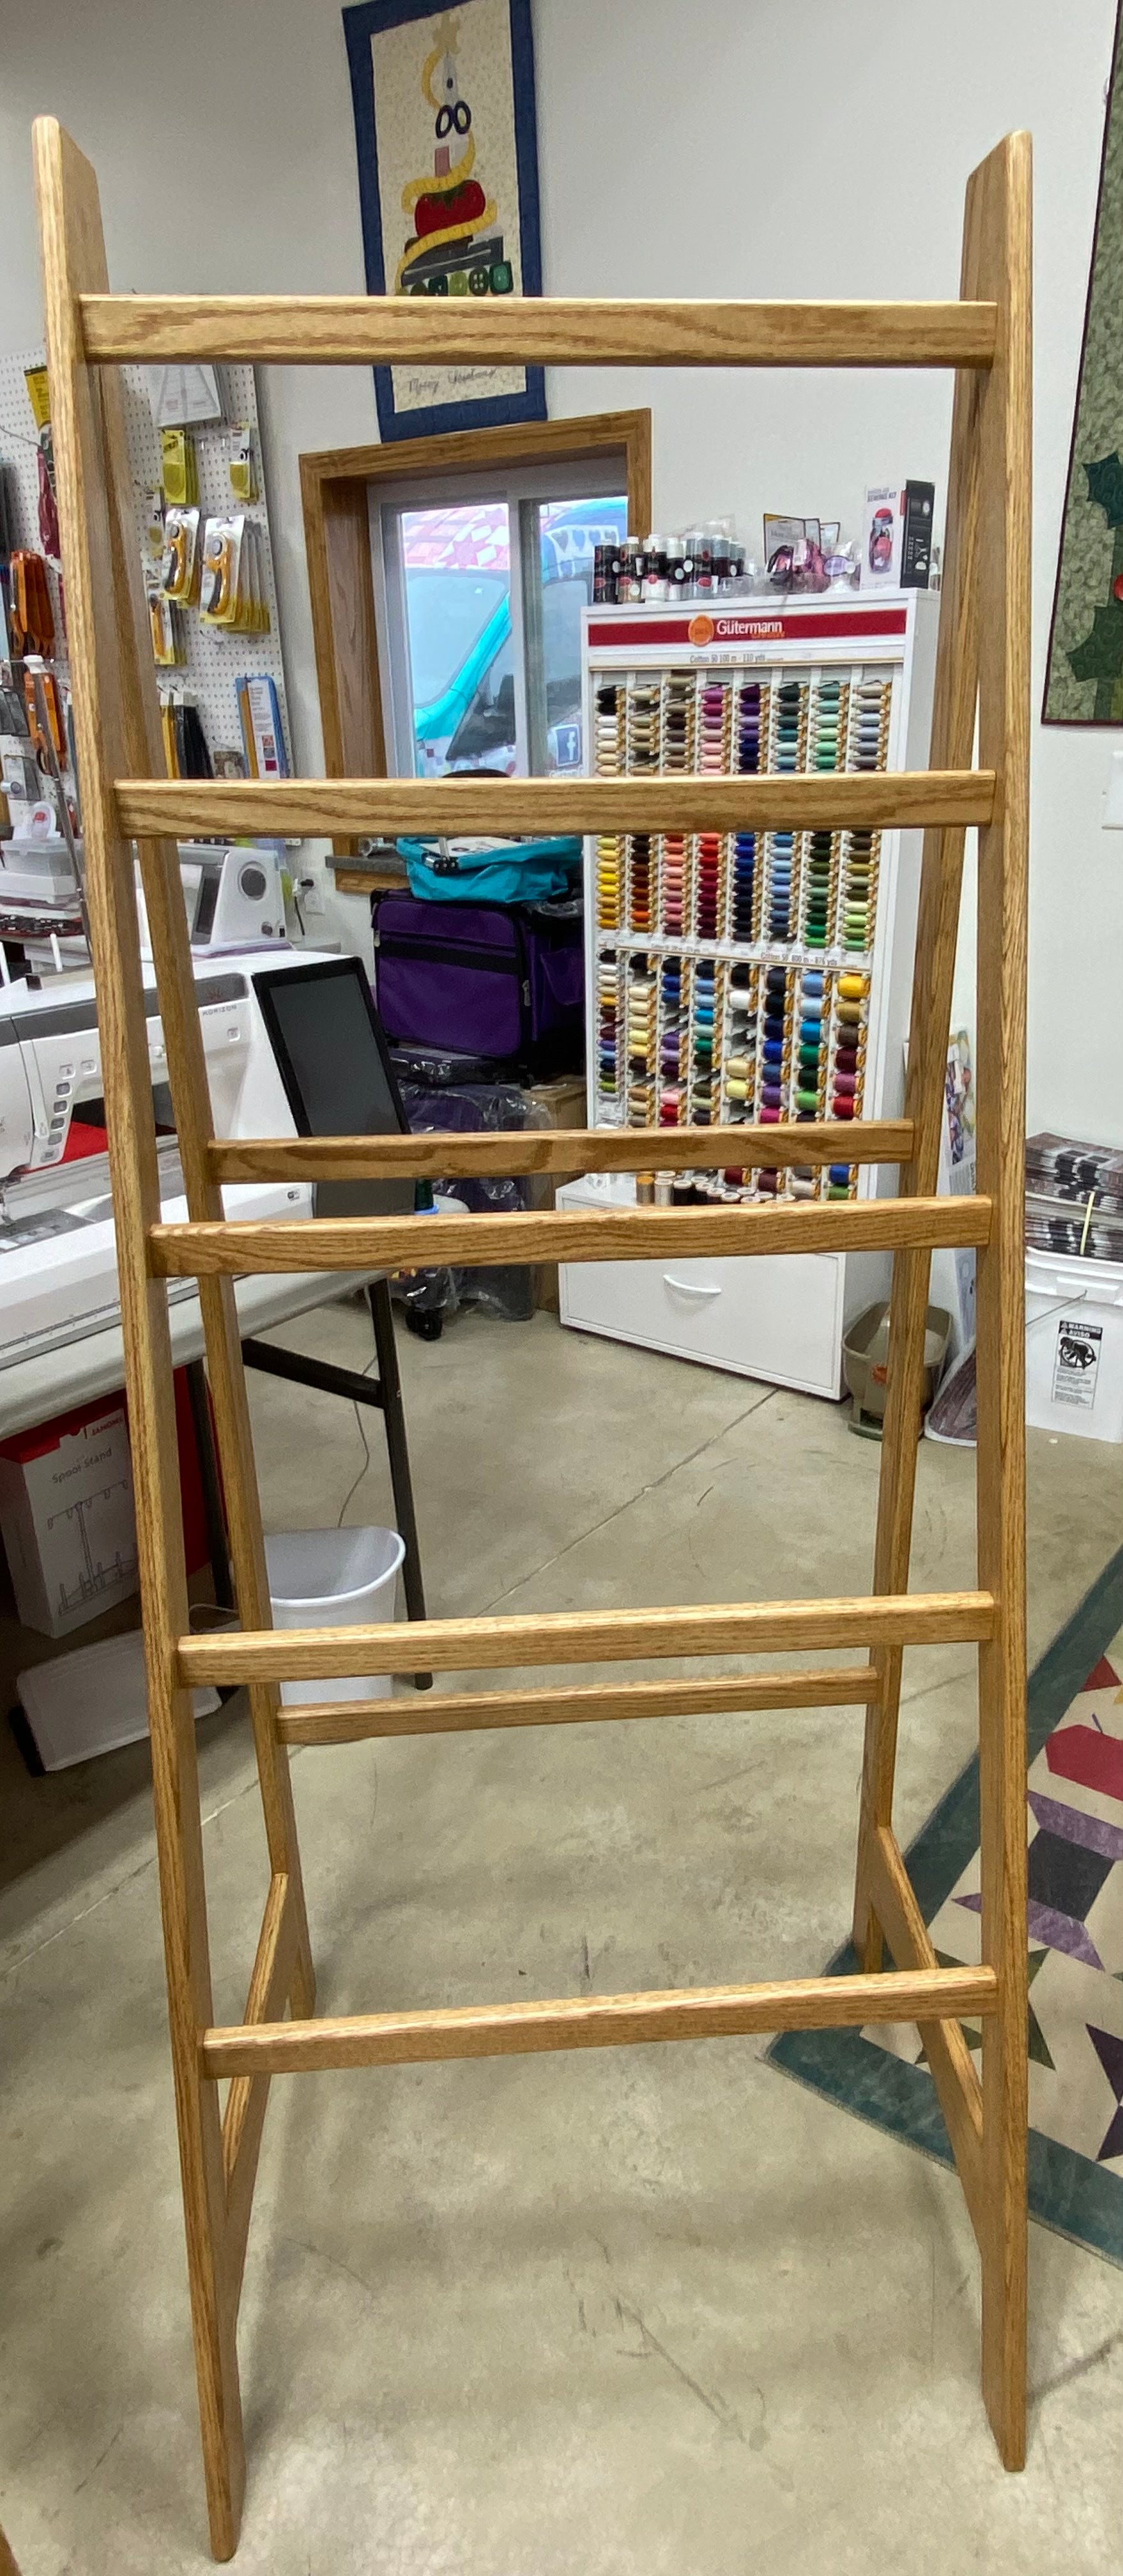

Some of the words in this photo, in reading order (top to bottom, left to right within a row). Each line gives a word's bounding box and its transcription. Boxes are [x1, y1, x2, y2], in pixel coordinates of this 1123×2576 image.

[717, 620, 783, 634] Gütermann
[690, 655, 710, 663] Cotton
[202, 1005, 237, 1015] HORIZON
[1068, 1323, 1101, 1334] WARNING
[1068, 1330, 1090, 1338] AVISO
[52, 1464, 82, 1483] Spool
[84, 1447, 112, 1468] Stand
